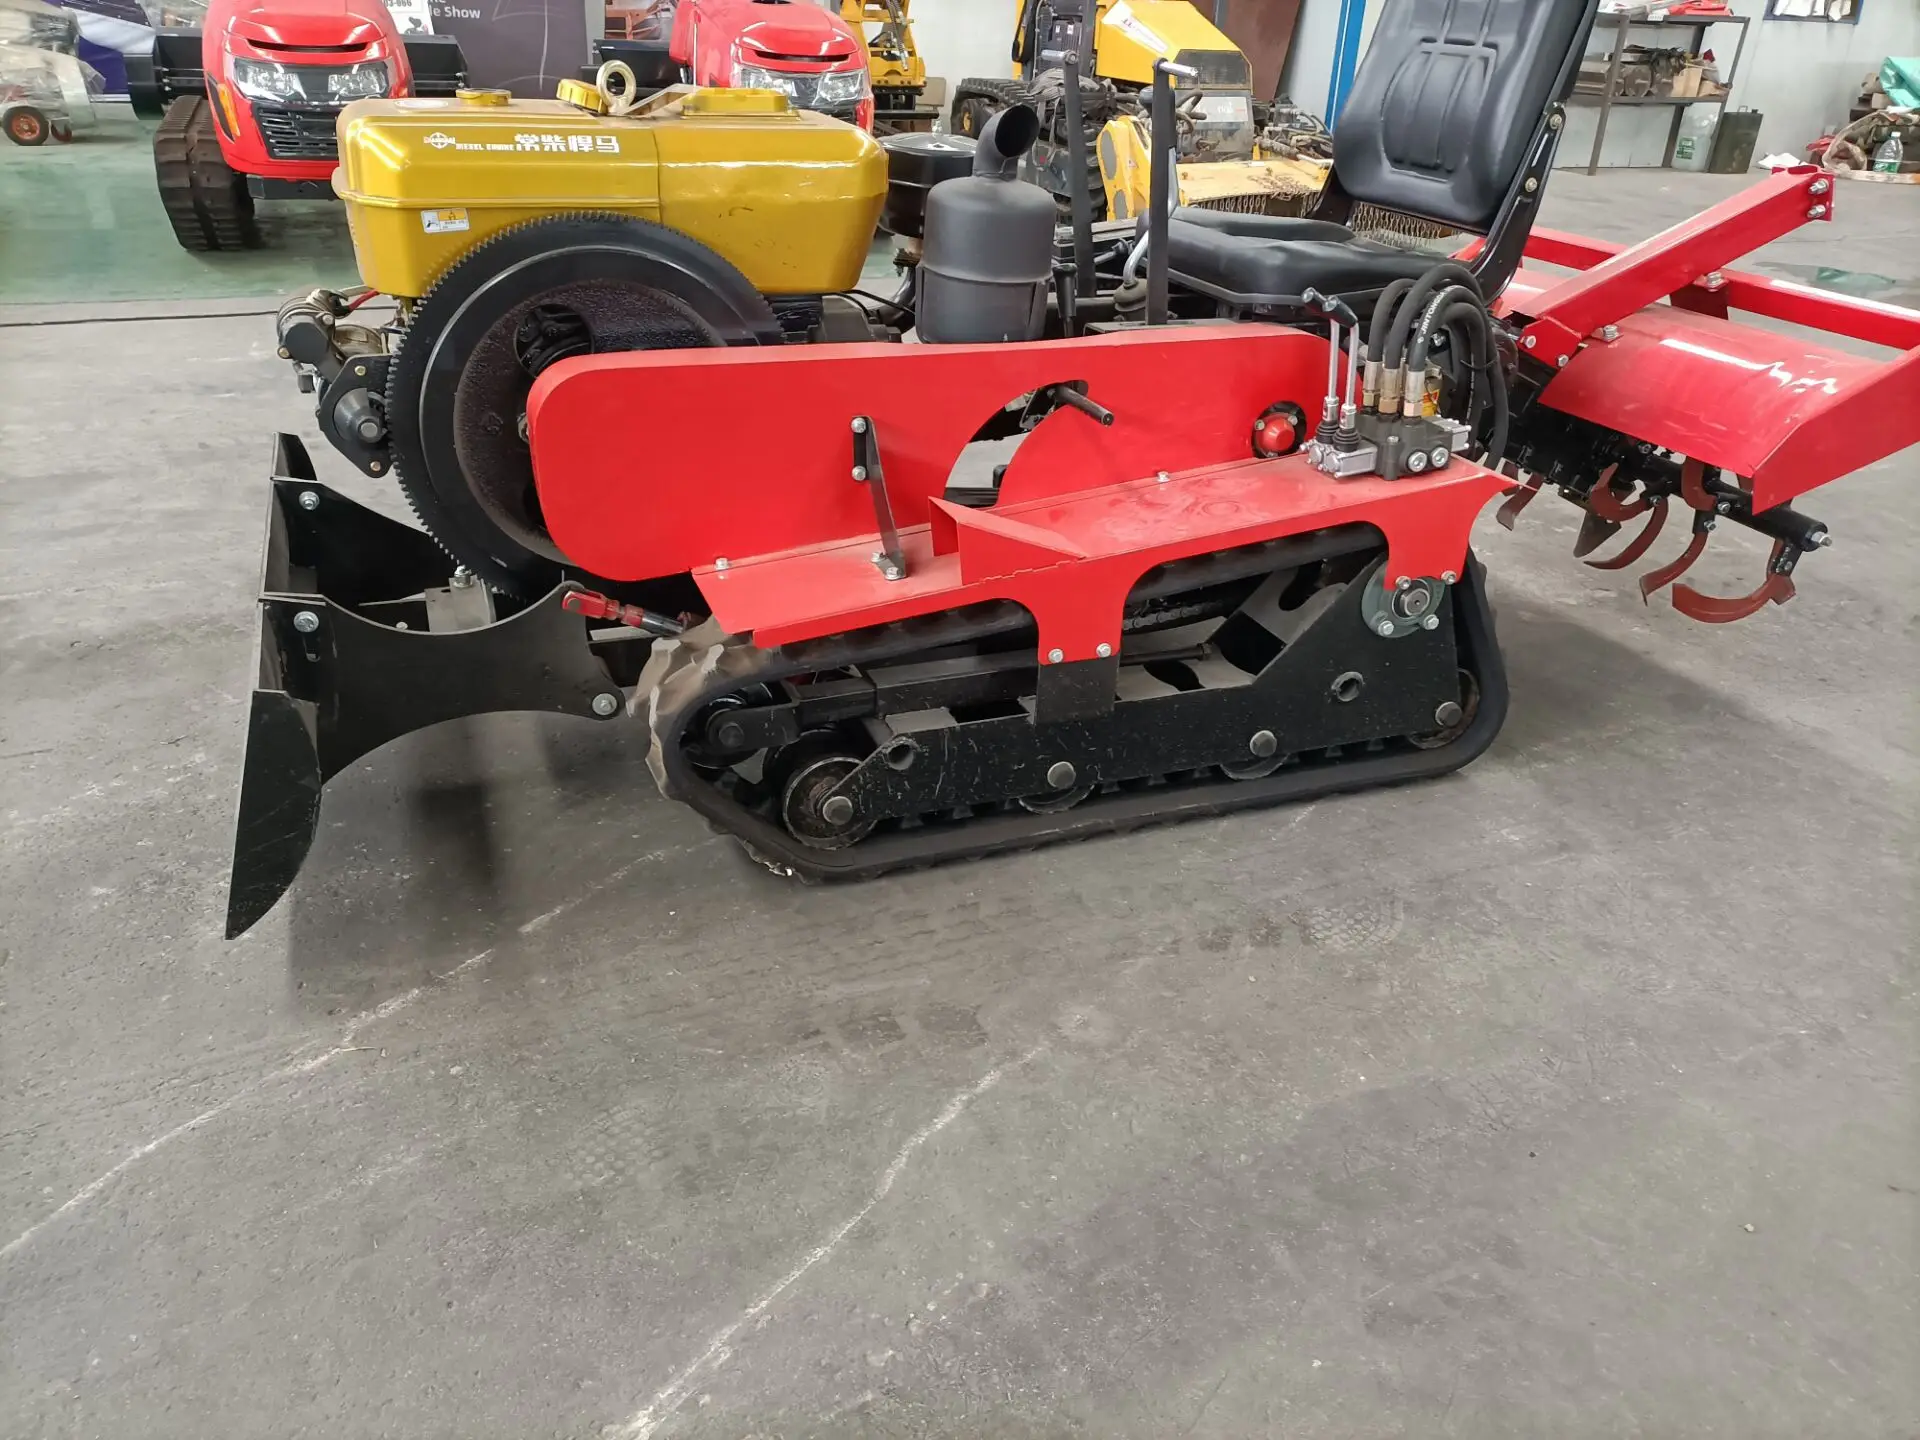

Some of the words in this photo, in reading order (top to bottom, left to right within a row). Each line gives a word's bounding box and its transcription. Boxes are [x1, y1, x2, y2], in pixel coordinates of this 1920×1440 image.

[444, 5, 481, 19] Show
[513, 133, 620, 153] 常柴悍马
